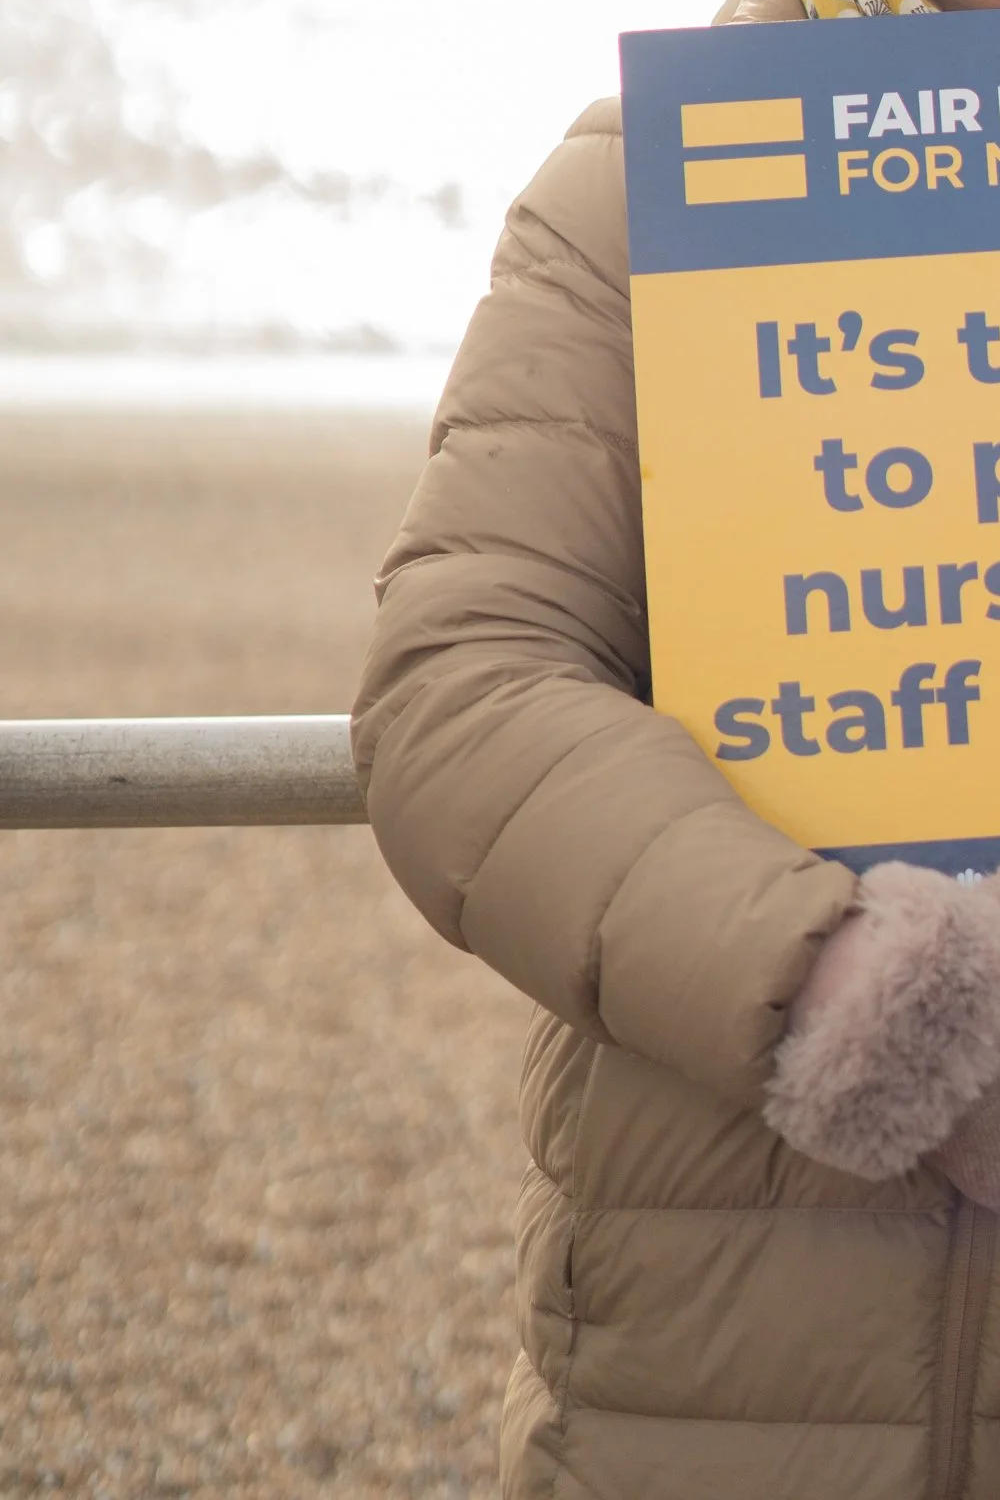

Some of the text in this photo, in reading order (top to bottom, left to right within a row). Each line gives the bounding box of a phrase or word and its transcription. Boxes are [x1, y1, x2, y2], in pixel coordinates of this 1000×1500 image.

[831, 87, 984, 141] FAIR
[836, 143, 966, 197] FOR
[756, 310, 926, 399] It's
[814, 438, 934, 512] to
[715, 660, 981, 761] staff
